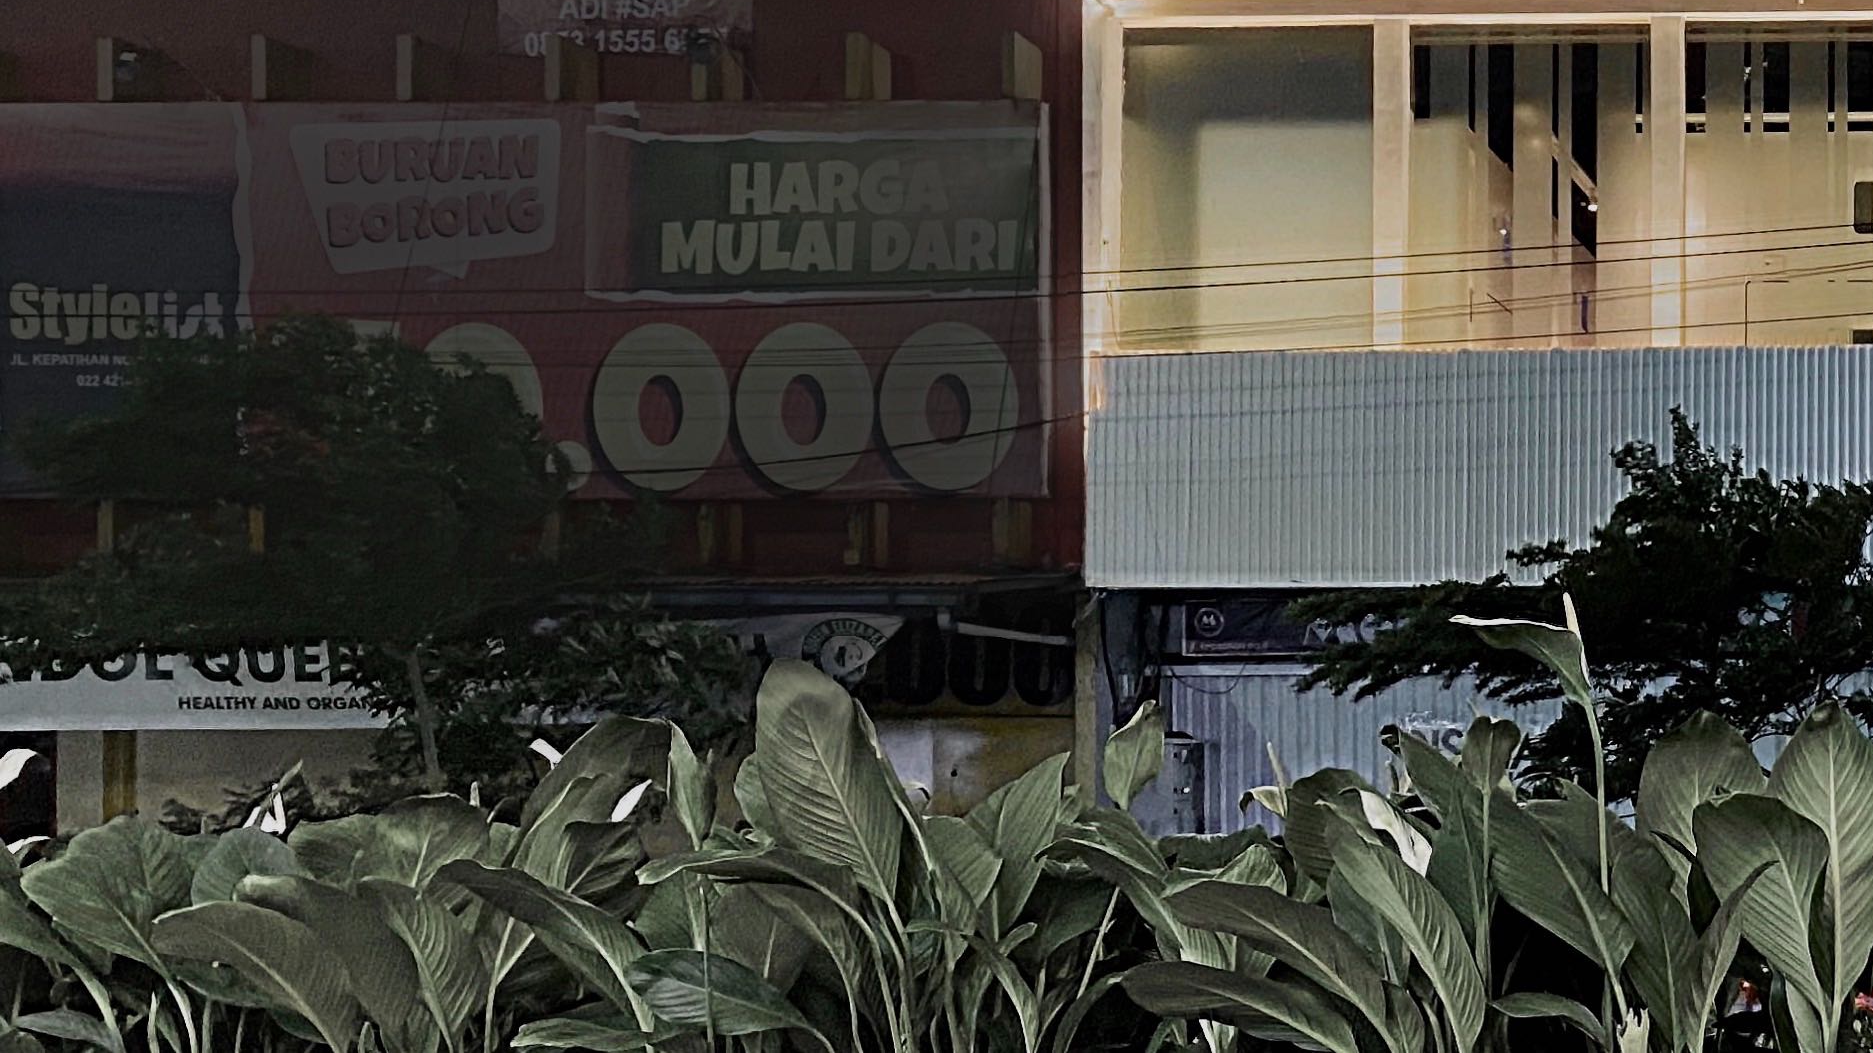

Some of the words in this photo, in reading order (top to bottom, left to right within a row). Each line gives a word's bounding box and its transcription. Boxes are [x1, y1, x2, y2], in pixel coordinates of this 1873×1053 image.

[595, 28, 656, 53] 1555
[323, 132, 541, 185] BURUAN
[728, 158, 950, 216] HARGA
[324, 186, 545, 248] BORONG
[660, 218, 858, 276] MULAI
[869, 218, 1019, 273] DARI
[32, 353, 110, 366] KEPATIHAN
[178, 696, 257, 710] HEALTHY
[262, 696, 301, 710] AND
[306, 696, 371, 710] ORGAN
